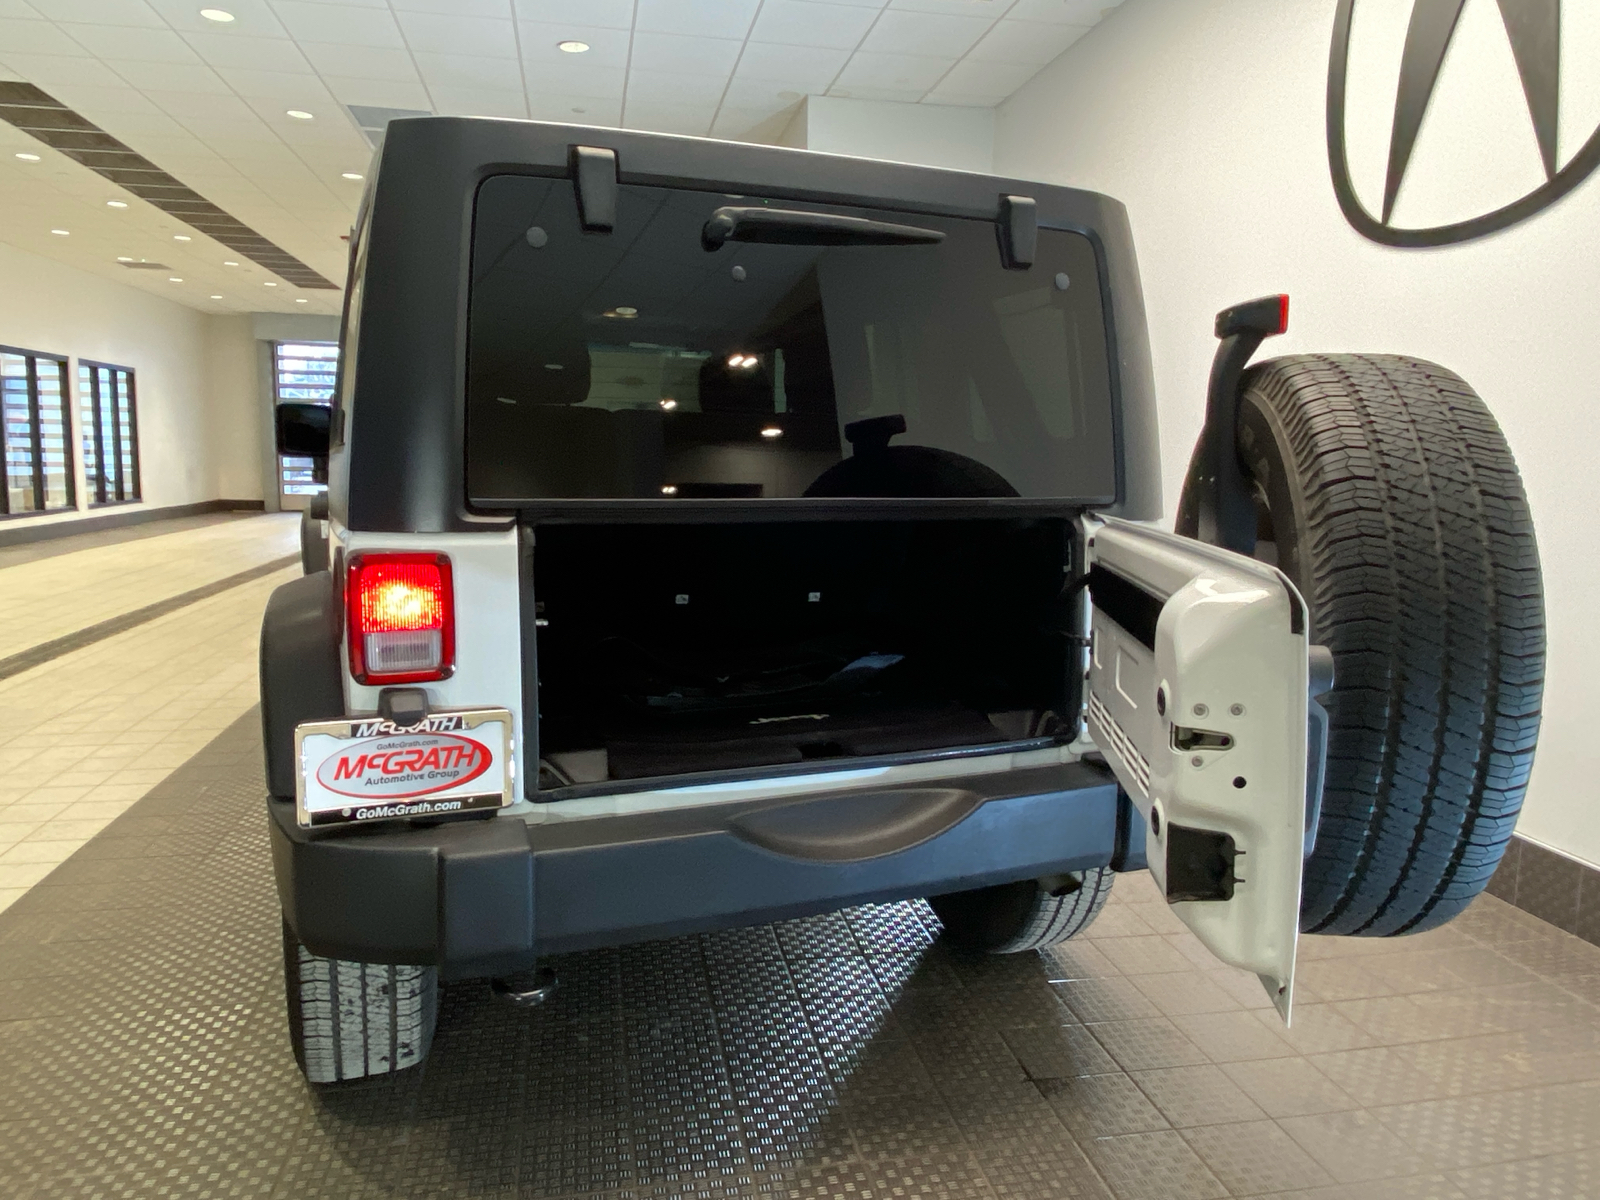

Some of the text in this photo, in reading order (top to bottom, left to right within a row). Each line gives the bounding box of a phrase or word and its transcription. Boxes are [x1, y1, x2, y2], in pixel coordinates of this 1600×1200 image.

[376, 738, 439, 751] GoMcGrath.com
[364, 769, 460, 786] Automotive Group
[356, 800, 461, 820] GoMcGrath.com
